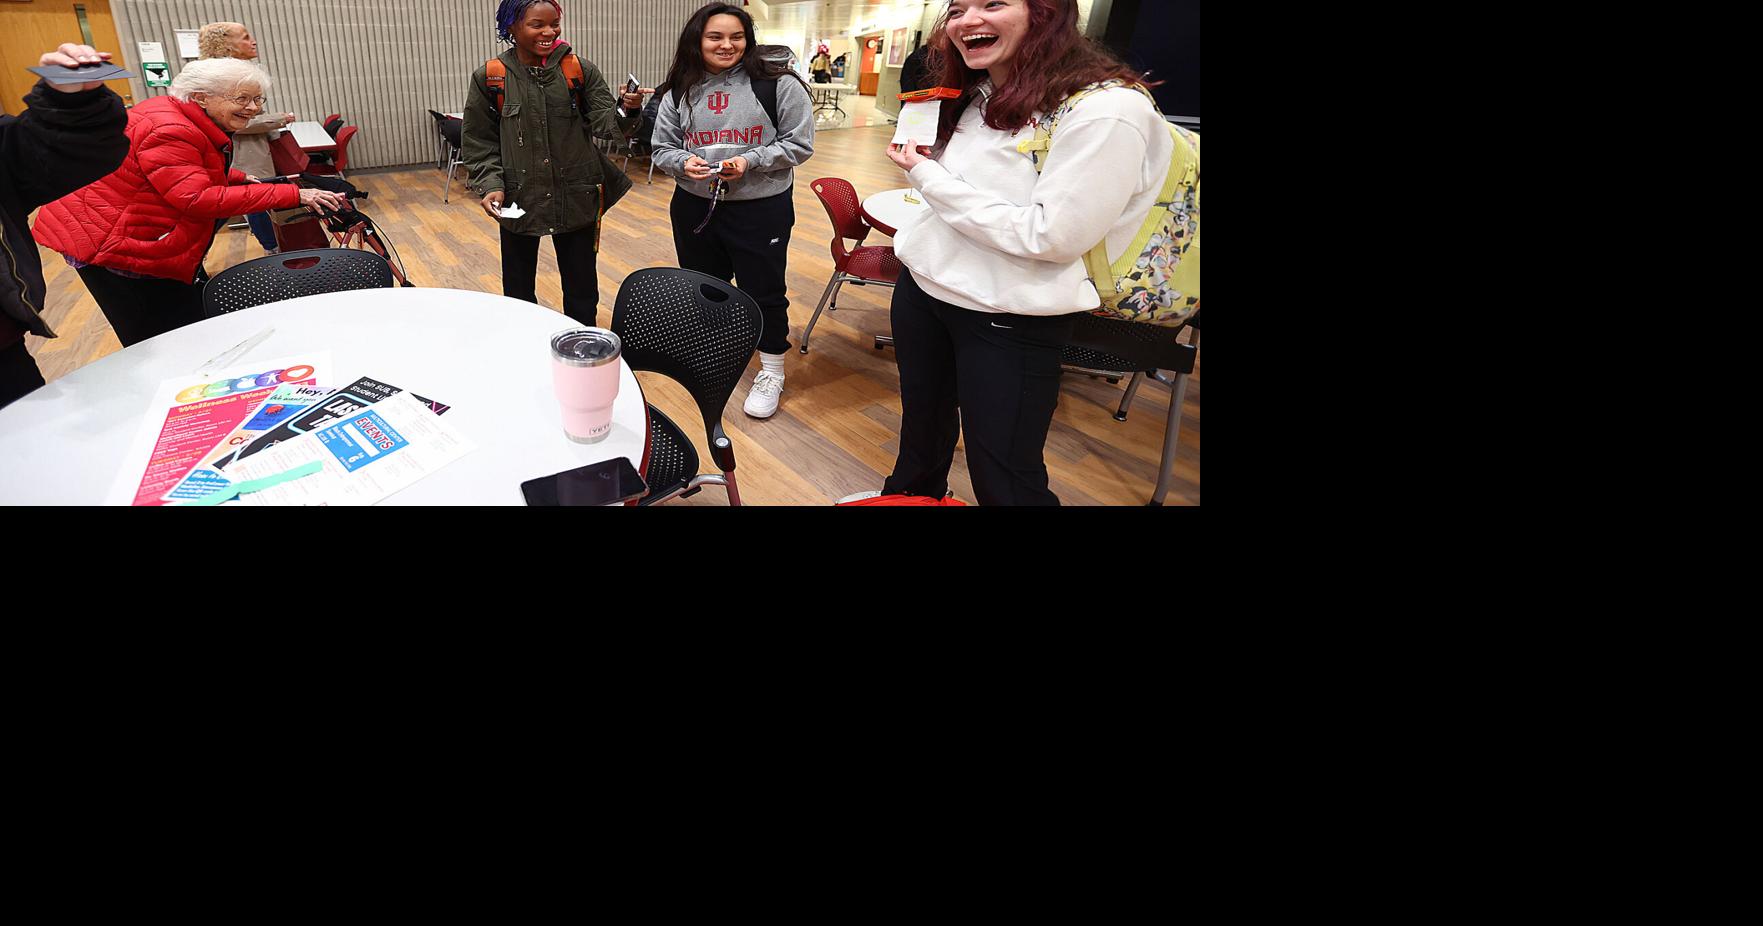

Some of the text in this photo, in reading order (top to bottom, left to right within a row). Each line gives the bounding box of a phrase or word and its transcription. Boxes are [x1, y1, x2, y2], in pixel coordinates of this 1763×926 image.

[360, 380, 376, 389] Join
[296, 387, 323, 396] Hey,
[350, 386, 379, 399] Student
[178, 397, 238, 412] Wellness
[355, 416, 396, 450] EVENTS
